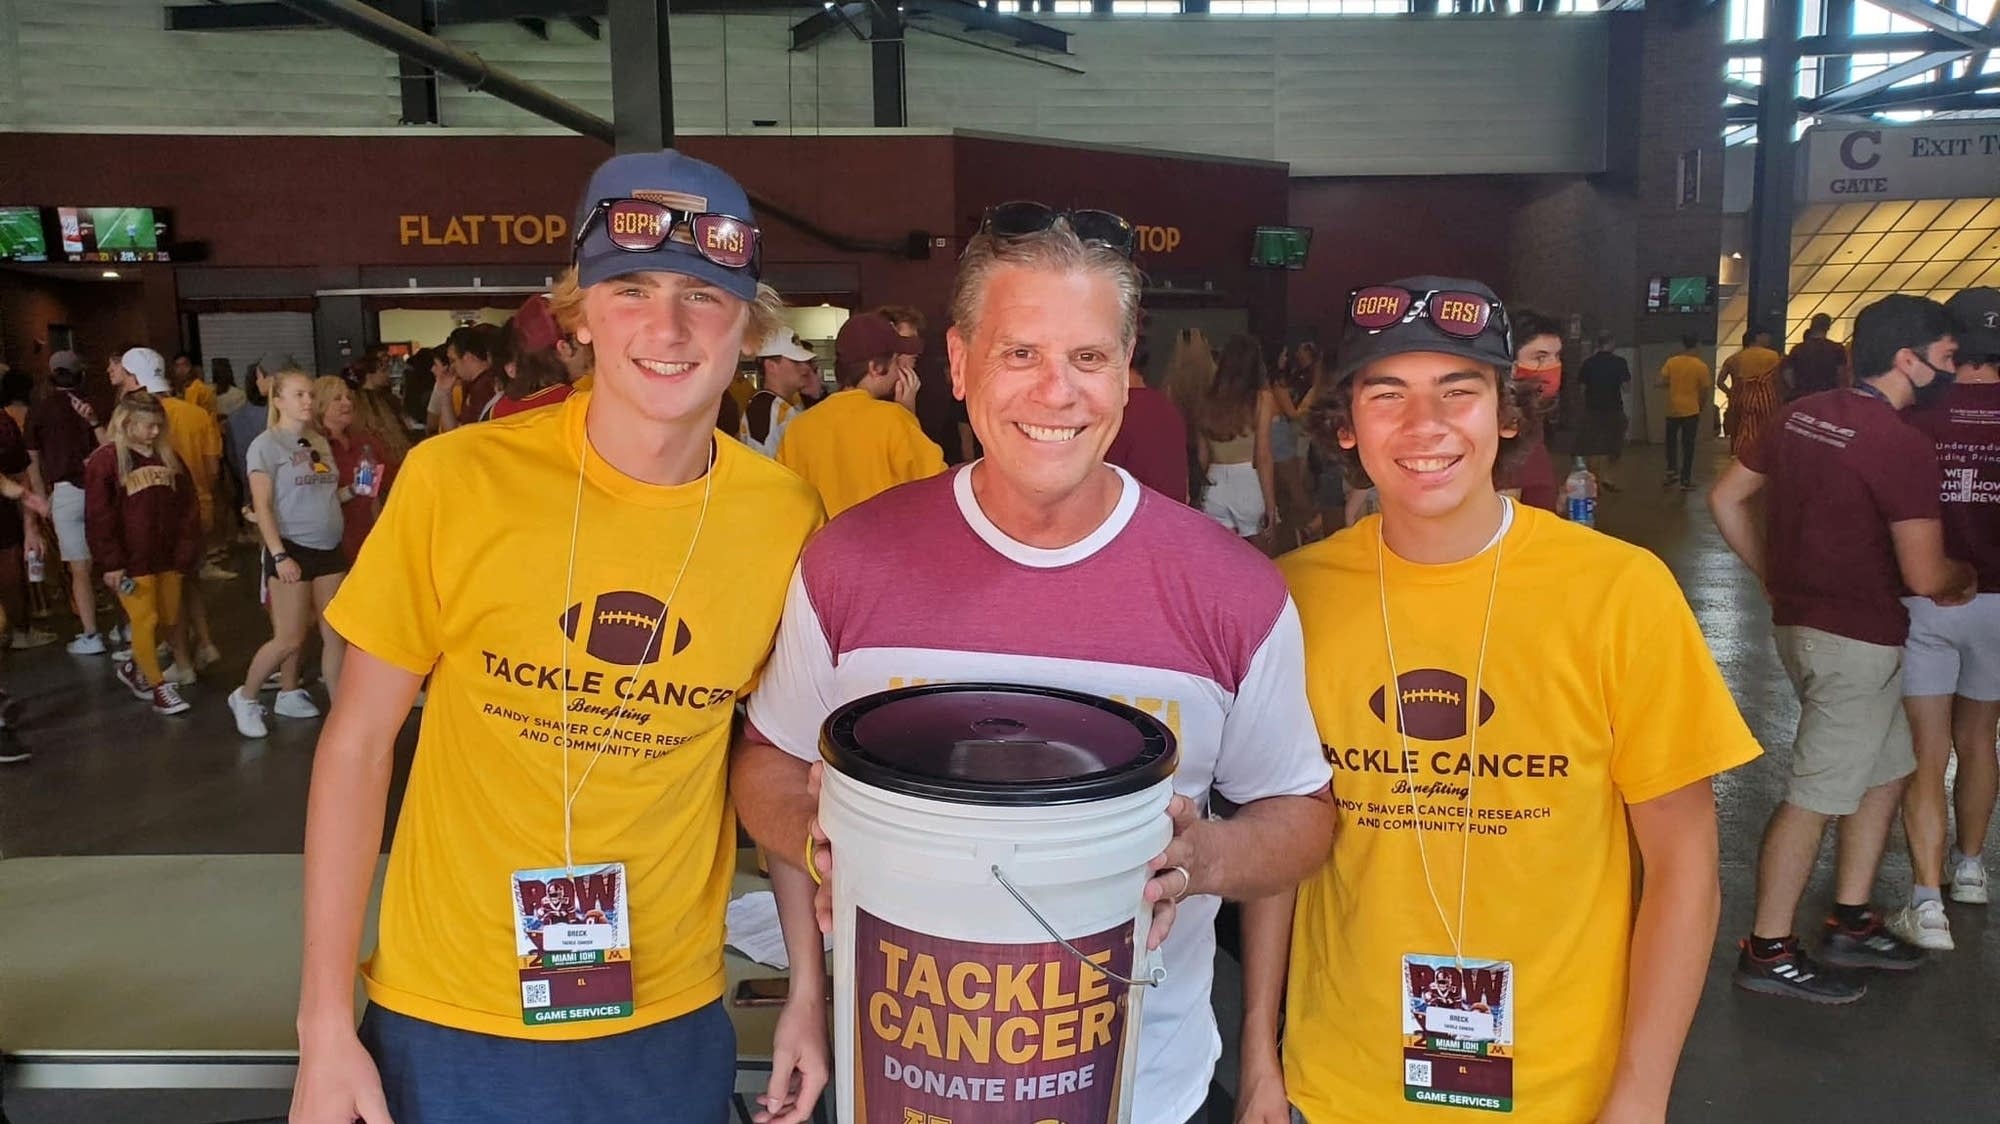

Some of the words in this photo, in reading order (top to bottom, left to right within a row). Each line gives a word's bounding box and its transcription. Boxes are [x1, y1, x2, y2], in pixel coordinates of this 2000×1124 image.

[1840, 130, 1881, 170] C
[1979, 134, 2000, 155] T
[1830, 177, 1888, 194] GATE
[400, 215, 485, 245] FLAT
[491, 215, 567, 245] TOP
[613, 212, 661, 236] GOPH
[1135, 225, 1181, 252] TOP
[1357, 296, 1399, 315] GOPH
[481, 650, 604, 694] TACKLE
[483, 703, 530, 723] RANDY
[534, 717, 588, 735] SHAVER
[593, 726, 652, 744] CANCER
[567, 697, 652, 725] Benefiting
[519, 728, 549, 743] AND
[553, 736, 640, 758] COMMUNITY
[1430, 751, 1569, 777] CANCER
[1391, 780, 1469, 800] Benefiting
[1335, 797, 1363, 811] ANDY
[1367, 803, 1414, 815] SHAVER
[1418, 805, 1473, 818] CANCER
[1478, 807, 1550, 820] RESEARCH
[1357, 816, 1381, 829] AND
[1384, 820, 1464, 833] COMMUNITY
[1468, 824, 1508, 836] FUND
[551, 953, 577, 963] MIAMI
[879, 939, 1112, 1012] TACKLE
[535, 1010, 567, 1021] GAME
[569, 1005, 621, 1018] SERVICES
[869, 991, 1116, 1065] CANCER
[1435, 1038, 1461, 1049] MIAMI
[884, 1054, 1006, 1102] DONATE
[1015, 1063, 1095, 1101] HERE
[1416, 1090, 1447, 1102] GAME
[1449, 1094, 1500, 1108] SERVICES
